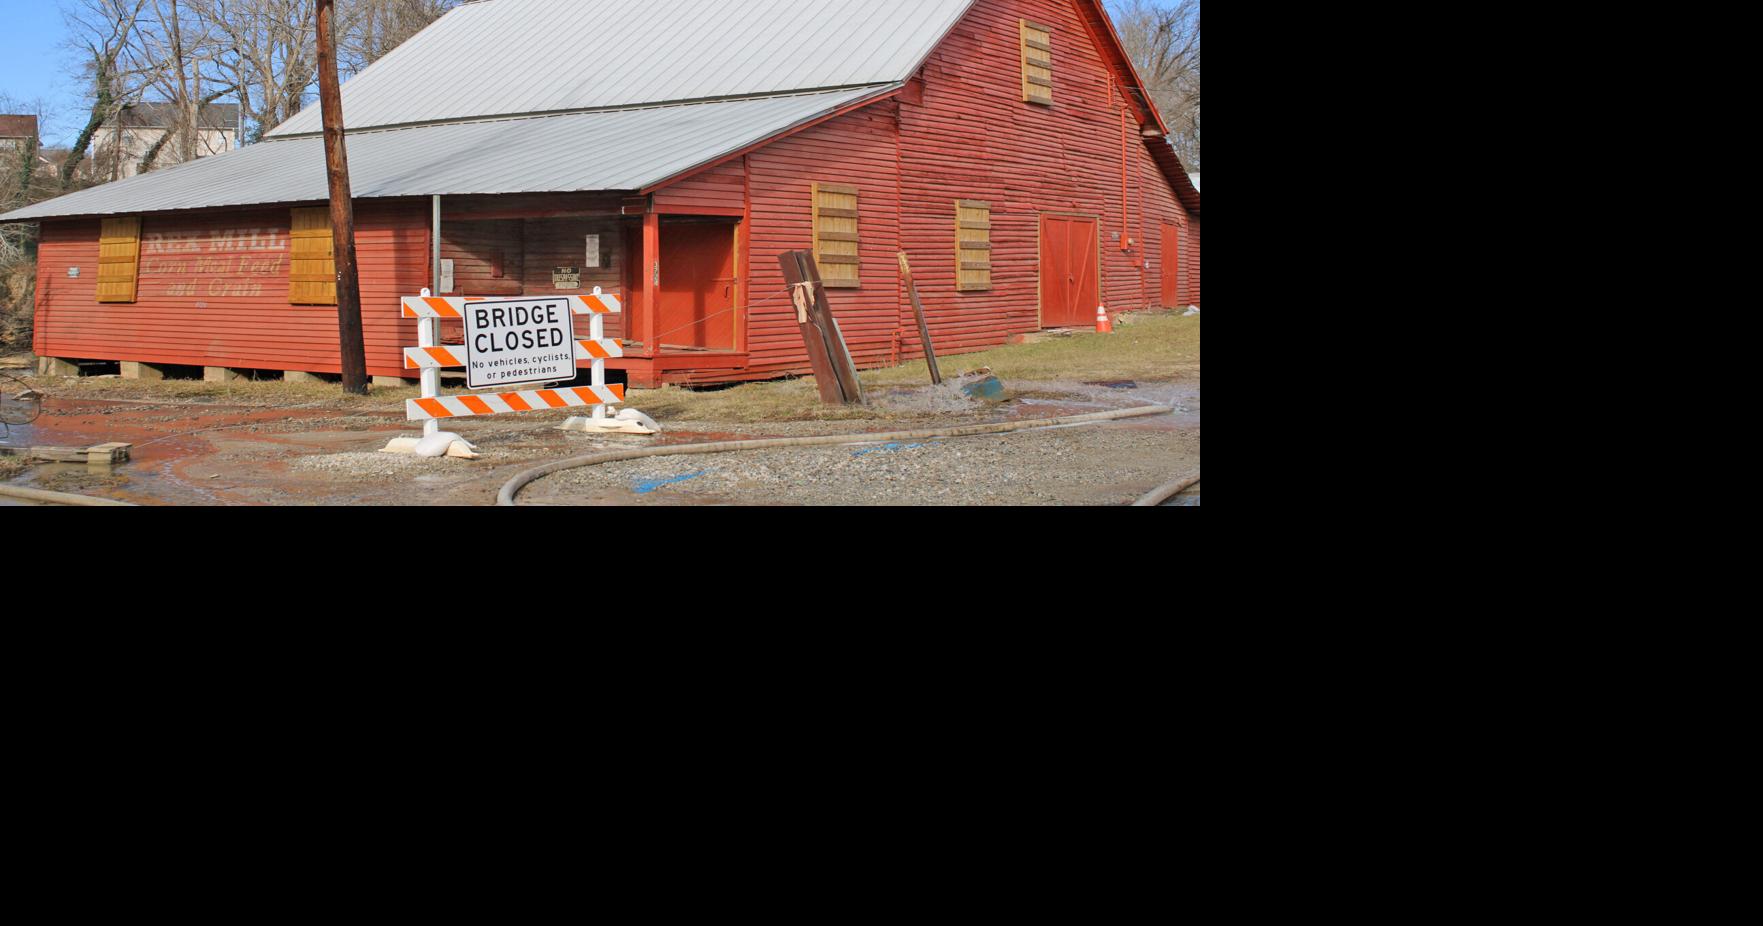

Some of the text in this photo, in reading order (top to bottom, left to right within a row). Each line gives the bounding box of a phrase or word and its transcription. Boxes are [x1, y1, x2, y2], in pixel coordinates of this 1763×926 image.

[208, 228, 286, 250] MILL
[146, 253, 284, 275] Corn Meal Feed
[166, 278, 262, 297] and Grain
[475, 304, 559, 329] BRIDGE
[475, 328, 563, 353] CLOSED
[472, 353, 570, 369] No vehicles, cyclists,
[486, 365, 557, 380] or pedestrians
